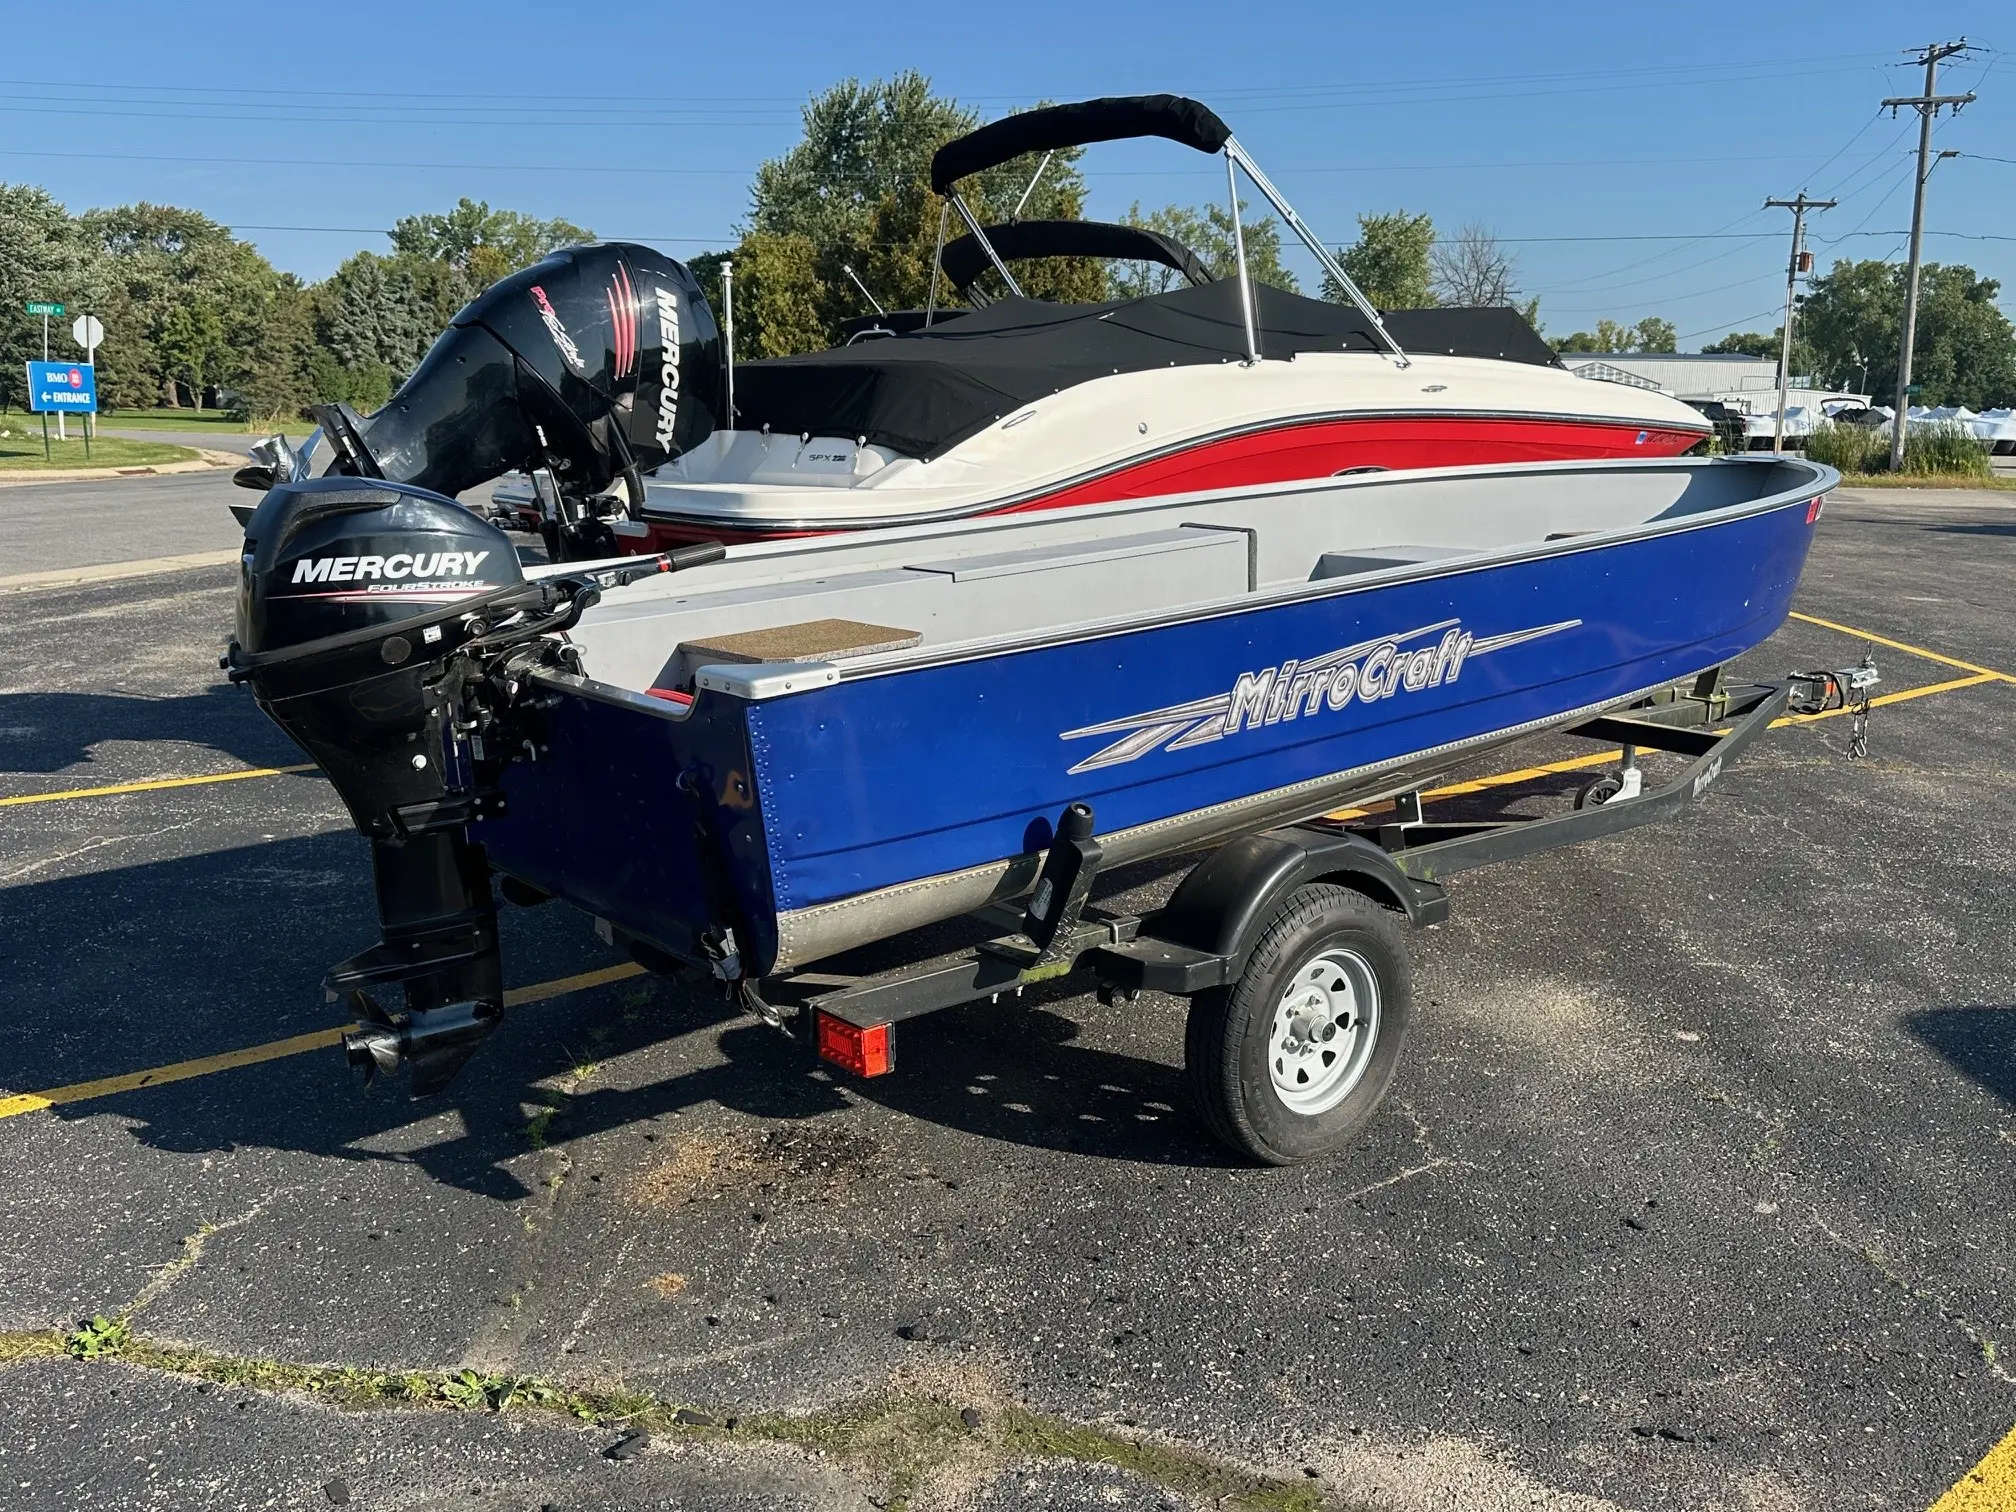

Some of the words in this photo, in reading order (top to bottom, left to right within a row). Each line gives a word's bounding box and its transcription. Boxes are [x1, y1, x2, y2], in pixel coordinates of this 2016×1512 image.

[30, 304, 54, 315] EASTWAY
[530, 285, 556, 317] Pro
[46, 372, 68, 383] BMO
[655, 286, 680, 455] MERCURY
[53, 391, 91, 404] ENTRANCE
[291, 551, 489, 583] MERCURY
[1223, 627, 1472, 736] MirroCraft
